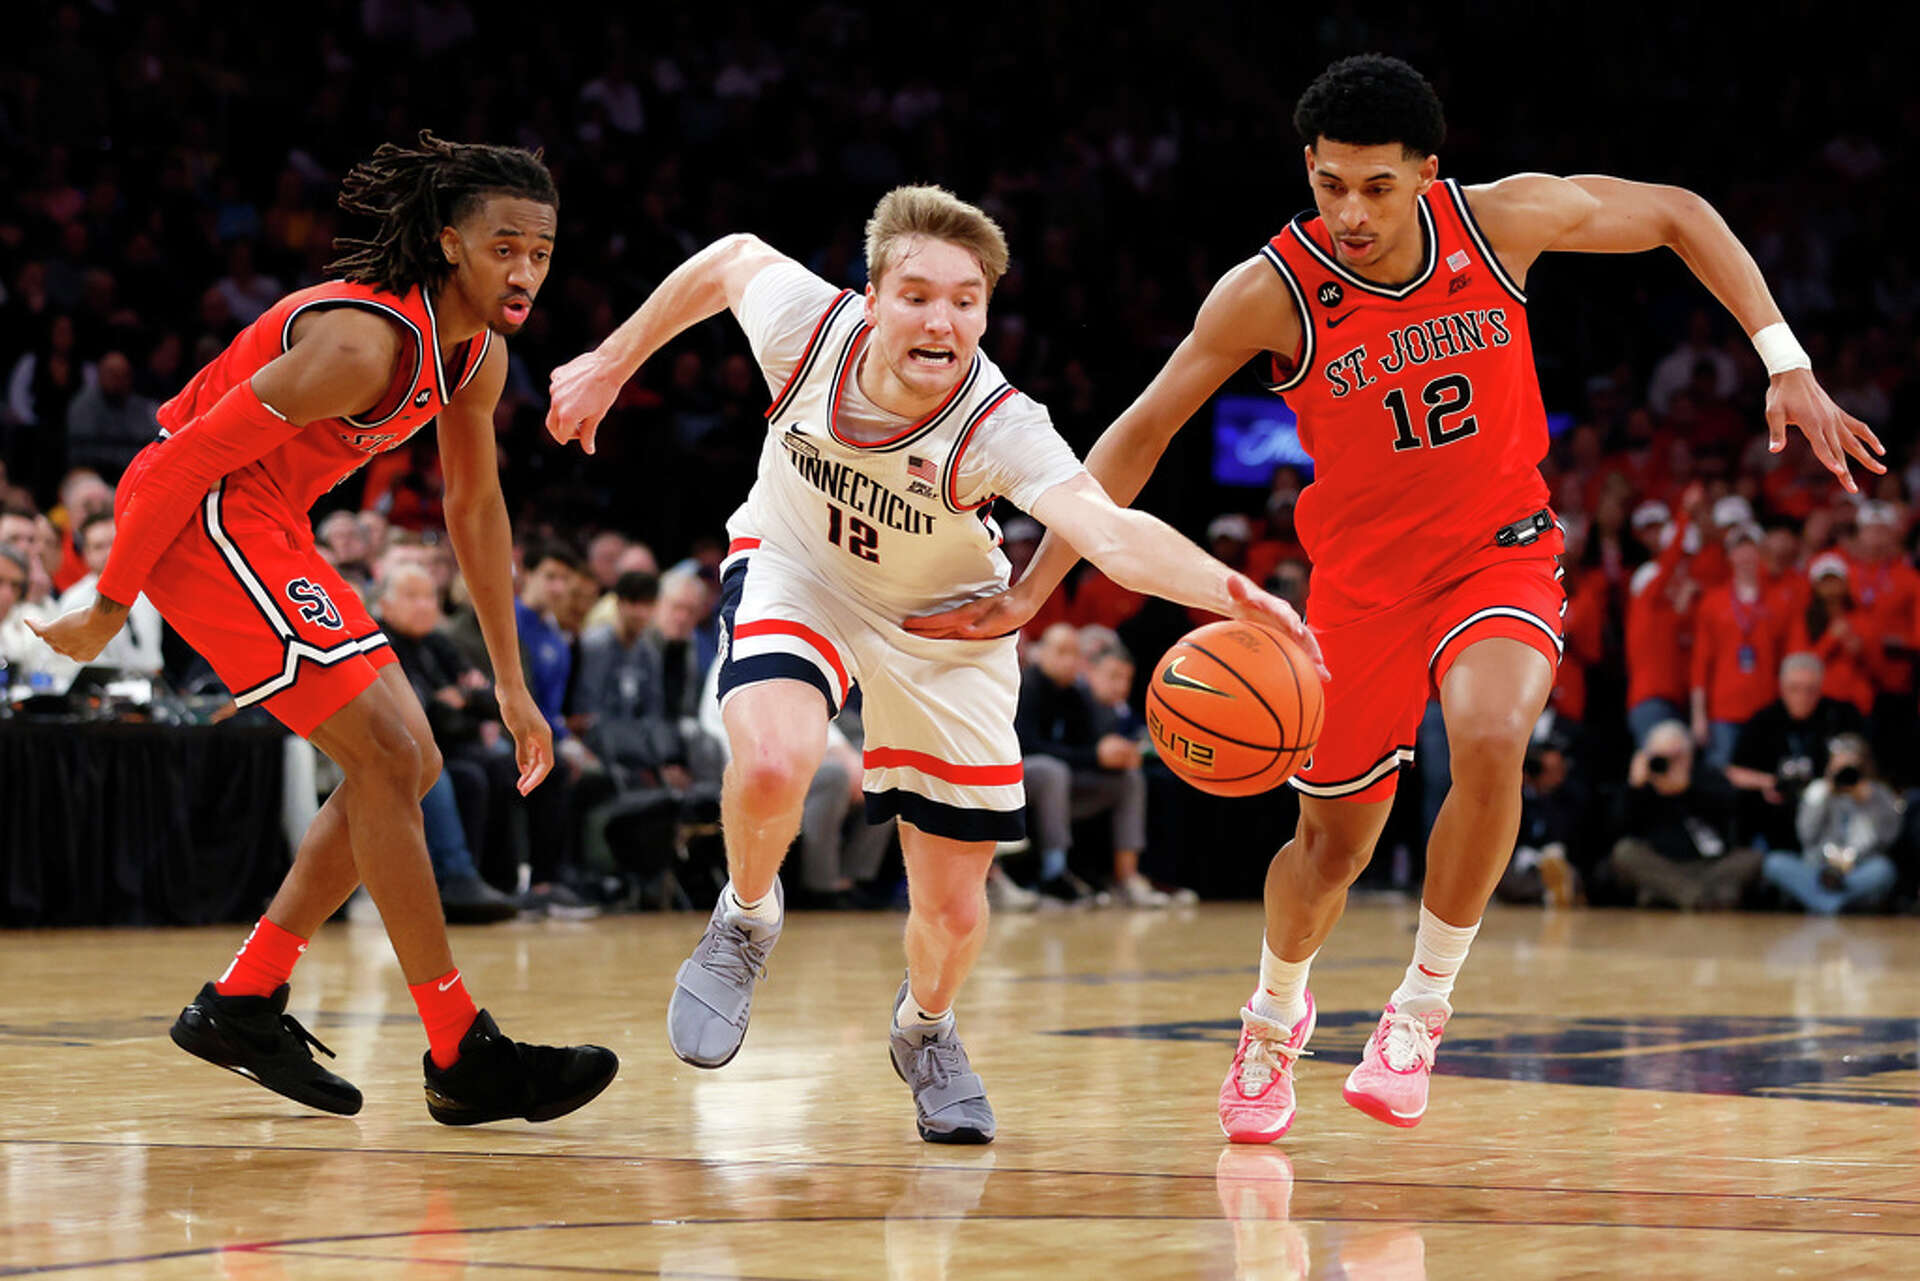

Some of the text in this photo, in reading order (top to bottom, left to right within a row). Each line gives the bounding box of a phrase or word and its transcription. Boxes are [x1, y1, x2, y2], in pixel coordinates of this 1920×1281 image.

[1320, 285, 1341, 302] JK
[1325, 308, 1512, 398] ST. JOHN'S
[1382, 373, 1479, 452] 12
[781, 441, 936, 535] NNECTICUT
[826, 502, 881, 564] 12
